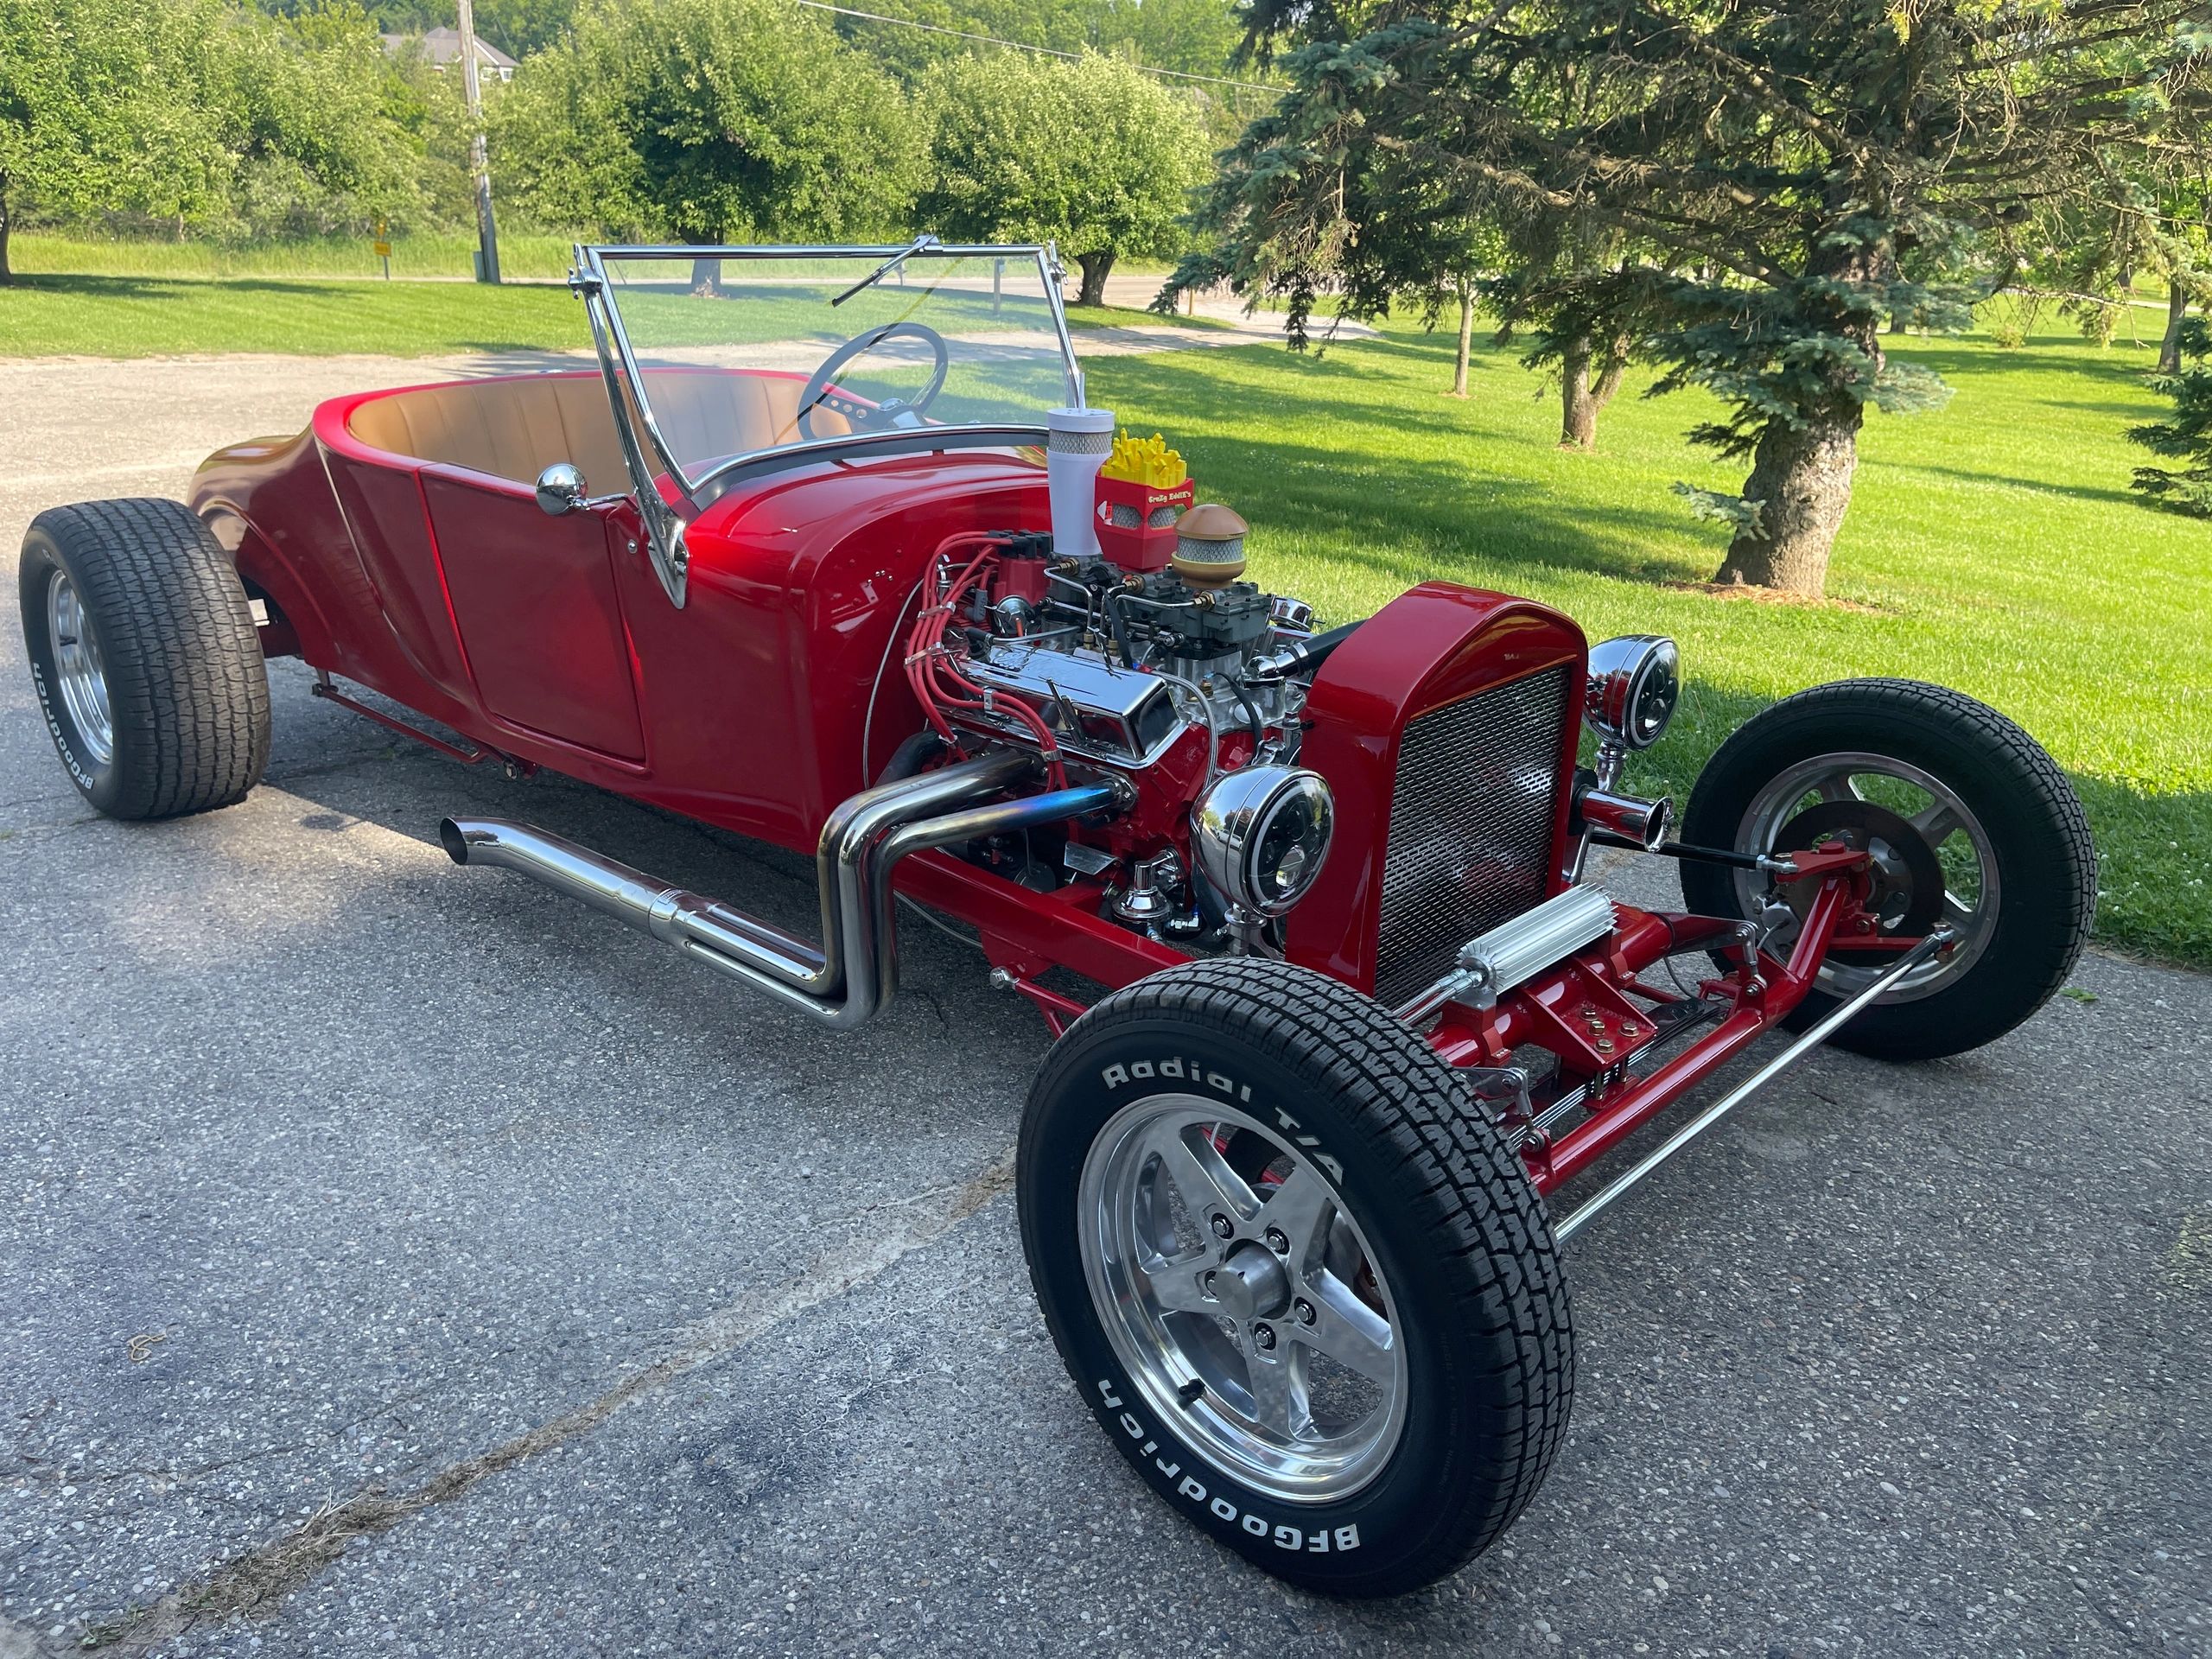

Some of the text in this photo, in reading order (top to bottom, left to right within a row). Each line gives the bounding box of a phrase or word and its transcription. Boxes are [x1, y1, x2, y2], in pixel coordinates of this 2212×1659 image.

[33, 663, 95, 790] BFGoodrich
[1102, 1057, 1344, 1186] Radial T/A
[1098, 1379, 1361, 1553] BFGoodrich
